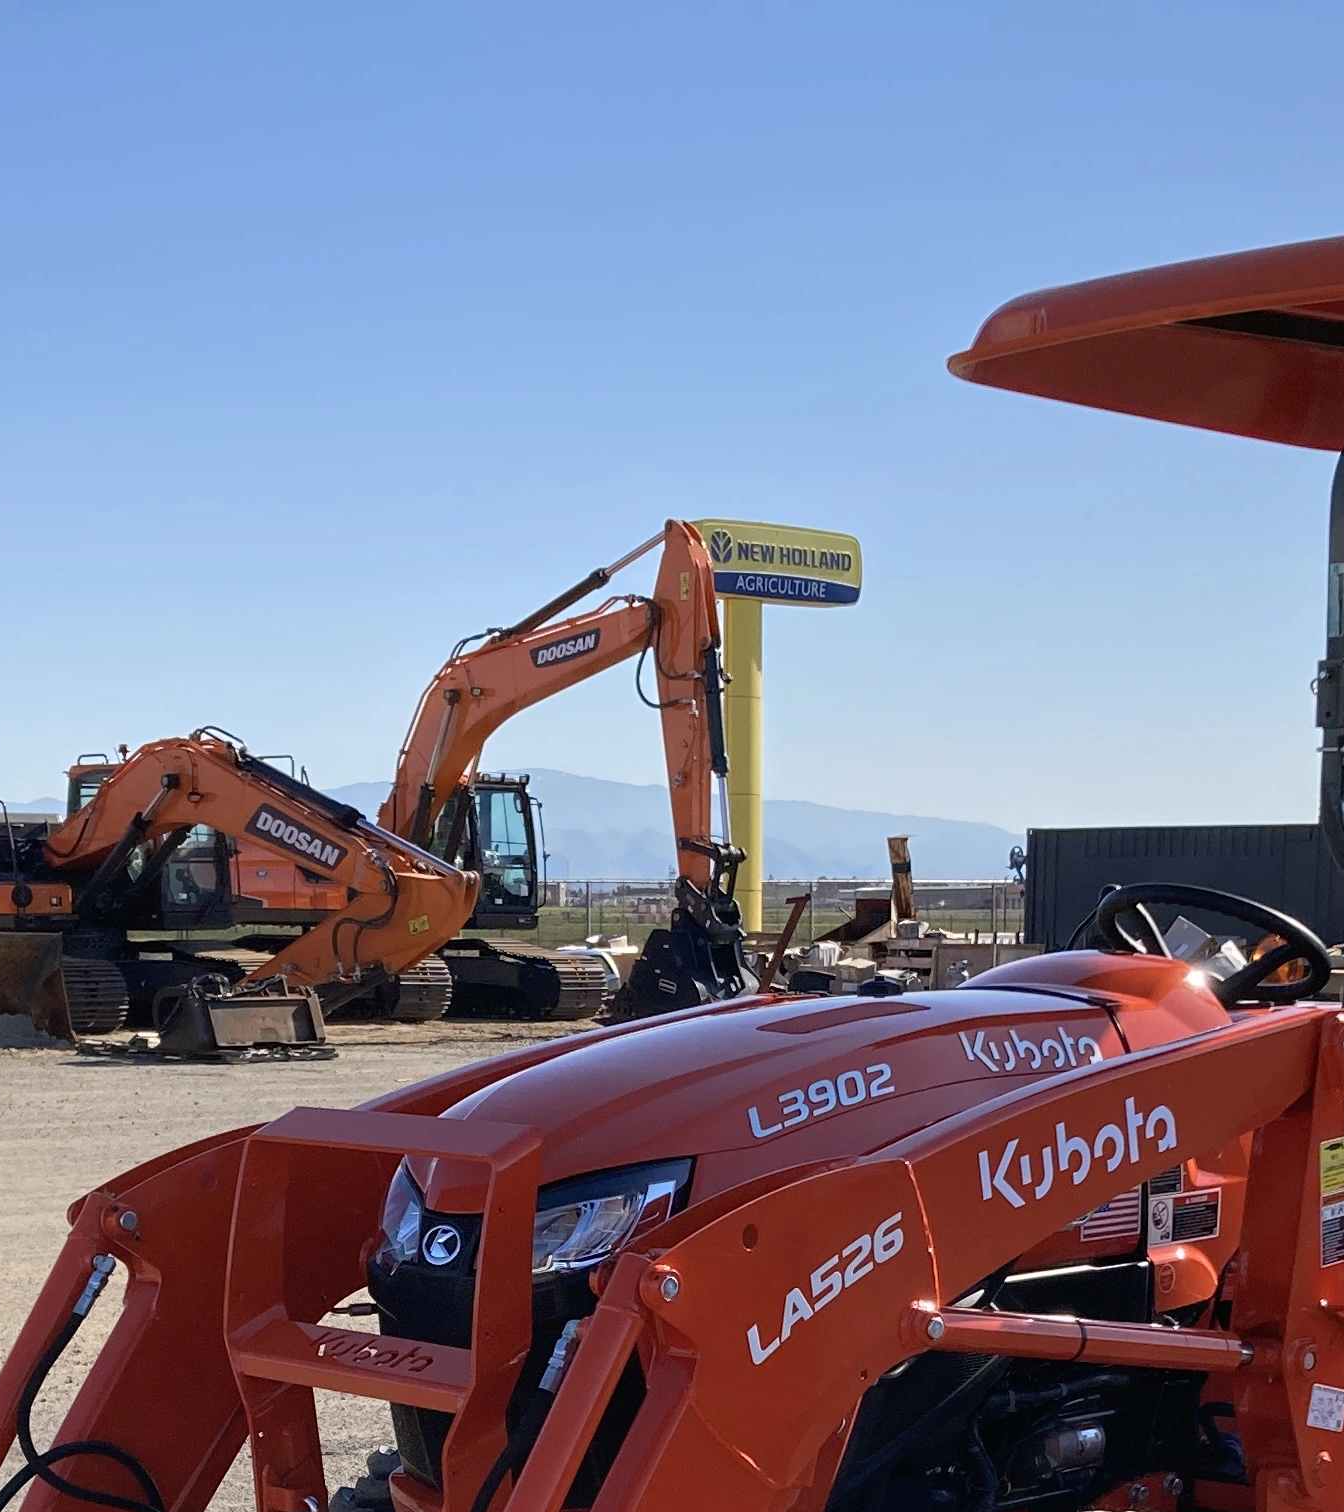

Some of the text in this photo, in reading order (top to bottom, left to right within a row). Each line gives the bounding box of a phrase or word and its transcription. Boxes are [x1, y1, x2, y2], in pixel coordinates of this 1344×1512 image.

[737, 541, 852, 572] NEW HOLLAND
[736, 574, 827, 598] AGRICULTURE
[537, 633, 596, 665] DOOSAN
[256, 811, 340, 867] DOOSAN
[958, 1026, 1104, 1073] Kubota
[747, 1063, 896, 1139] L3902
[978, 1096, 1178, 1209] Kubota
[747, 1211, 905, 1366] LA526
[310, 1331, 434, 1372] Kubota
